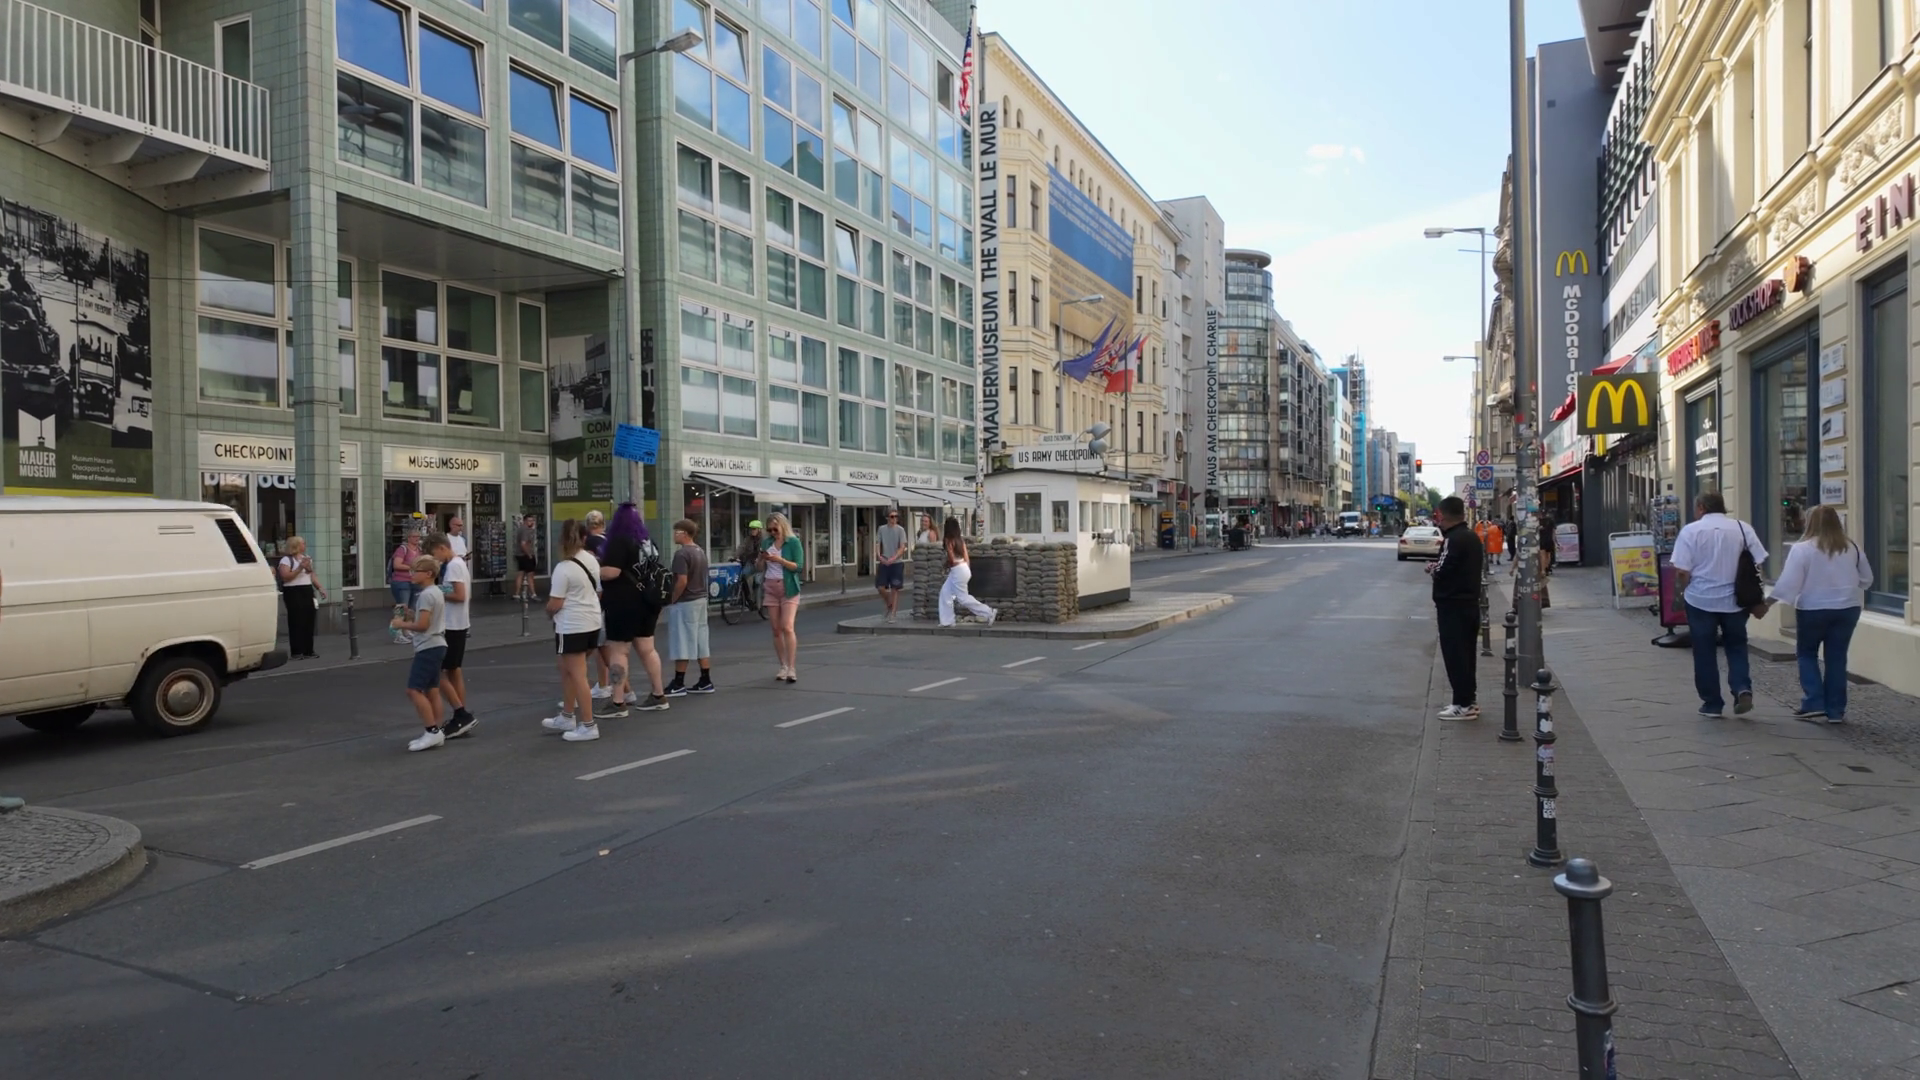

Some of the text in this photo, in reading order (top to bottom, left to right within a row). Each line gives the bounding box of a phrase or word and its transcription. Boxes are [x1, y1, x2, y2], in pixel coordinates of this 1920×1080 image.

[1856, 171, 1920, 253] EIN
[980, 109, 999, 446] MAUERMUSEUM THE WALL LE MUR
[1207, 310, 1217, 486] HAUS AM CHECKPOINT CHARLIE
[589, 438, 610, 449] AND
[19, 449, 57, 466] MAUER
[71, 454, 94, 463] Museum
[214, 443, 294, 461] CHECKPOINT
[1032, 450, 1053, 463] ARMY
[1055, 446, 1099, 461] CHECKPOINT
[19, 464, 57, 478] MUSEUM
[71, 464, 100, 473] Checkpoint
[408, 455, 480, 471] MUSEUMSSHOP
[689, 456, 752, 472] CHECKPOINT CHARLIE
[72, 473, 88, 481] Home
[556, 479, 579, 489] MAUER
